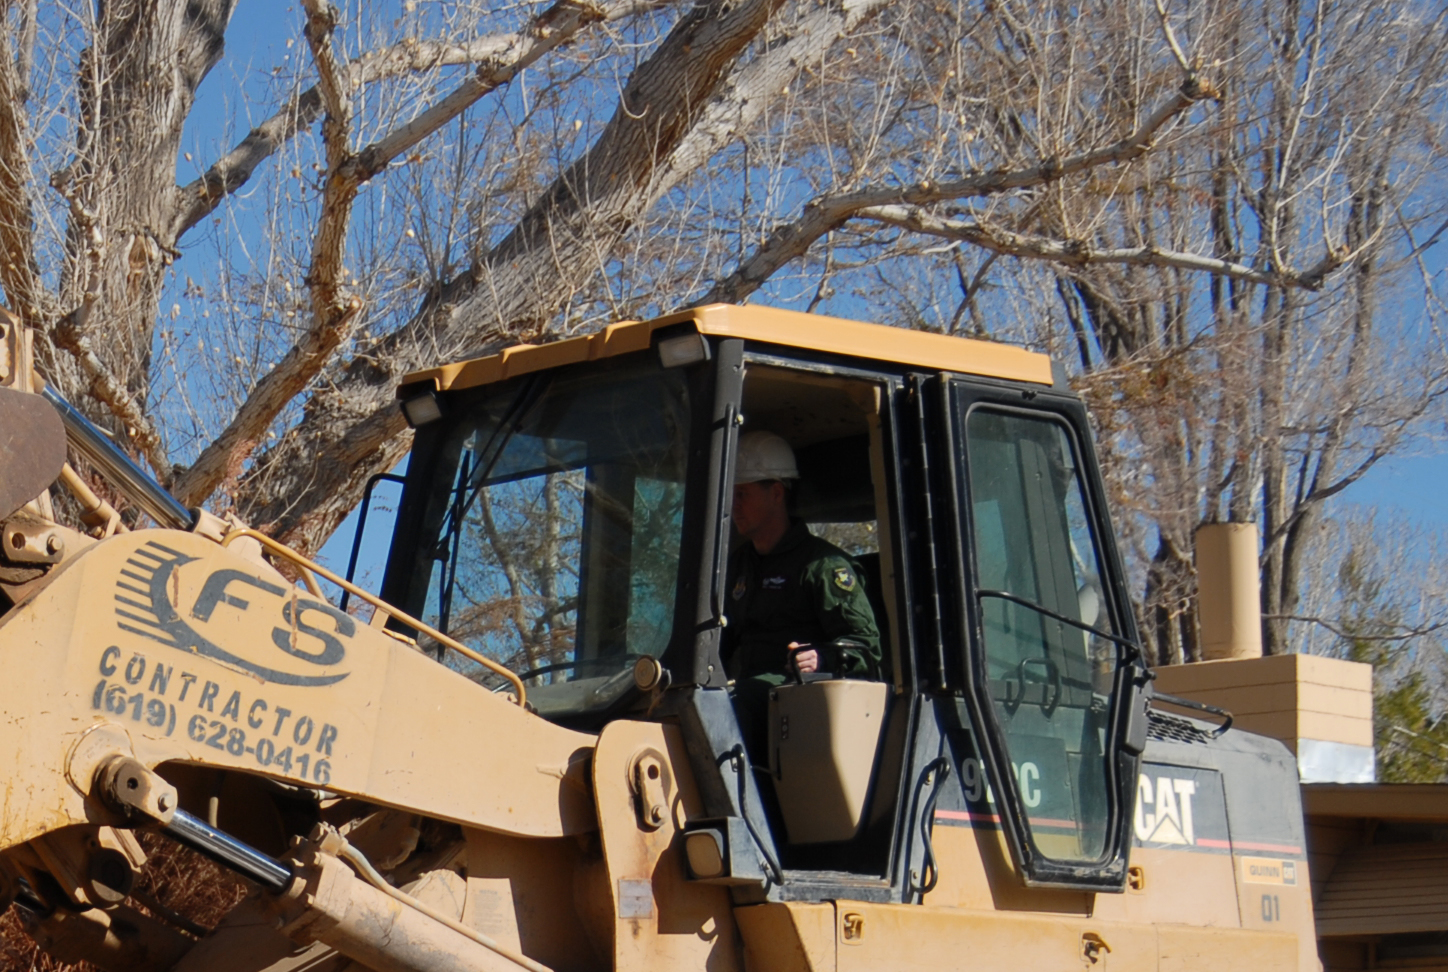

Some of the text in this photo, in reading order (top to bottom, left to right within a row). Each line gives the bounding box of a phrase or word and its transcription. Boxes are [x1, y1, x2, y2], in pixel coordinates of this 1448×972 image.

[189, 569, 356, 665] FS
[93, 680, 332, 786] (619) 628-0416
[99, 645, 338, 756] CONTRACTOR
[1134, 773, 1195, 845] CAT
[1249, 865, 1280, 877] QUINN
